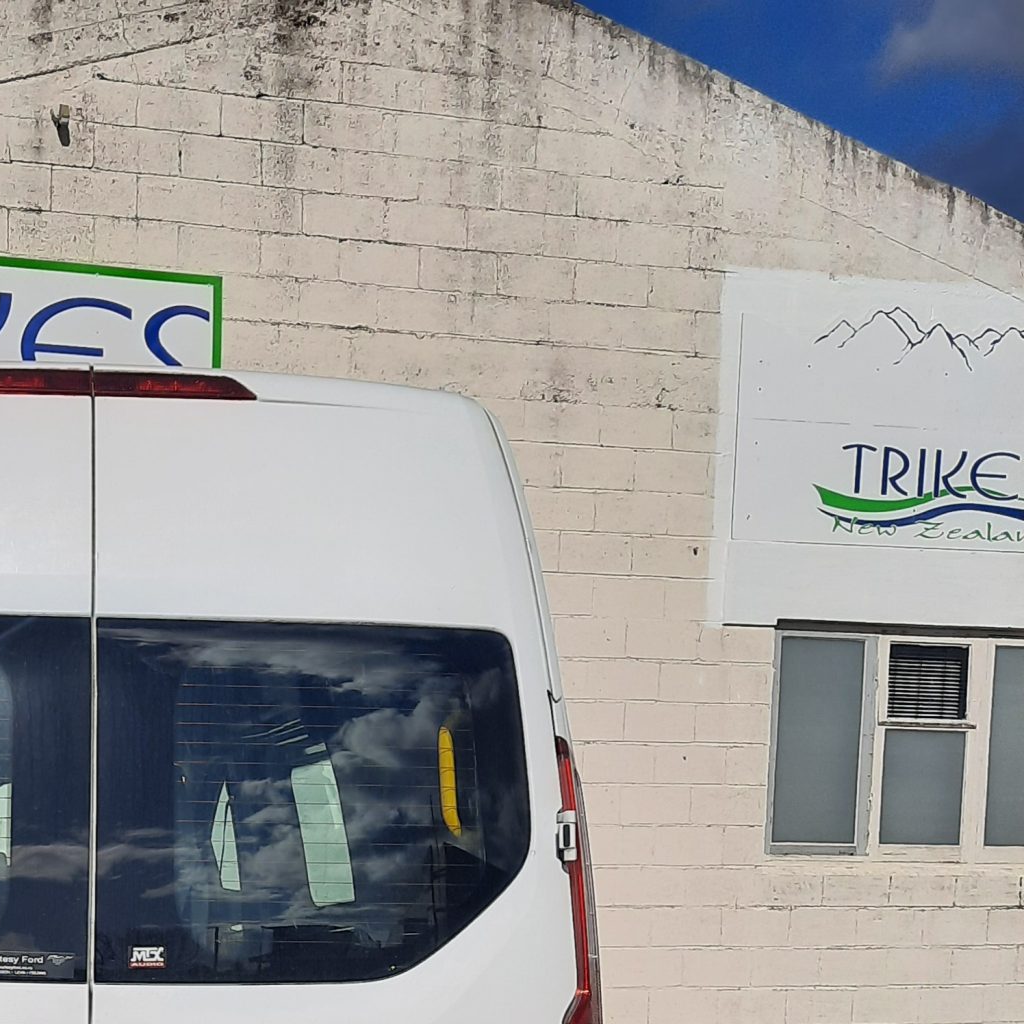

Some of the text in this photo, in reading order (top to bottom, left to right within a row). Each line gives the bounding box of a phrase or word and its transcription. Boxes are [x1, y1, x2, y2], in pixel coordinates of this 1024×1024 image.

[842, 444, 1022, 500] TRIKE
[832, 515, 897, 536] New
[21, 955, 44, 964] Ford
